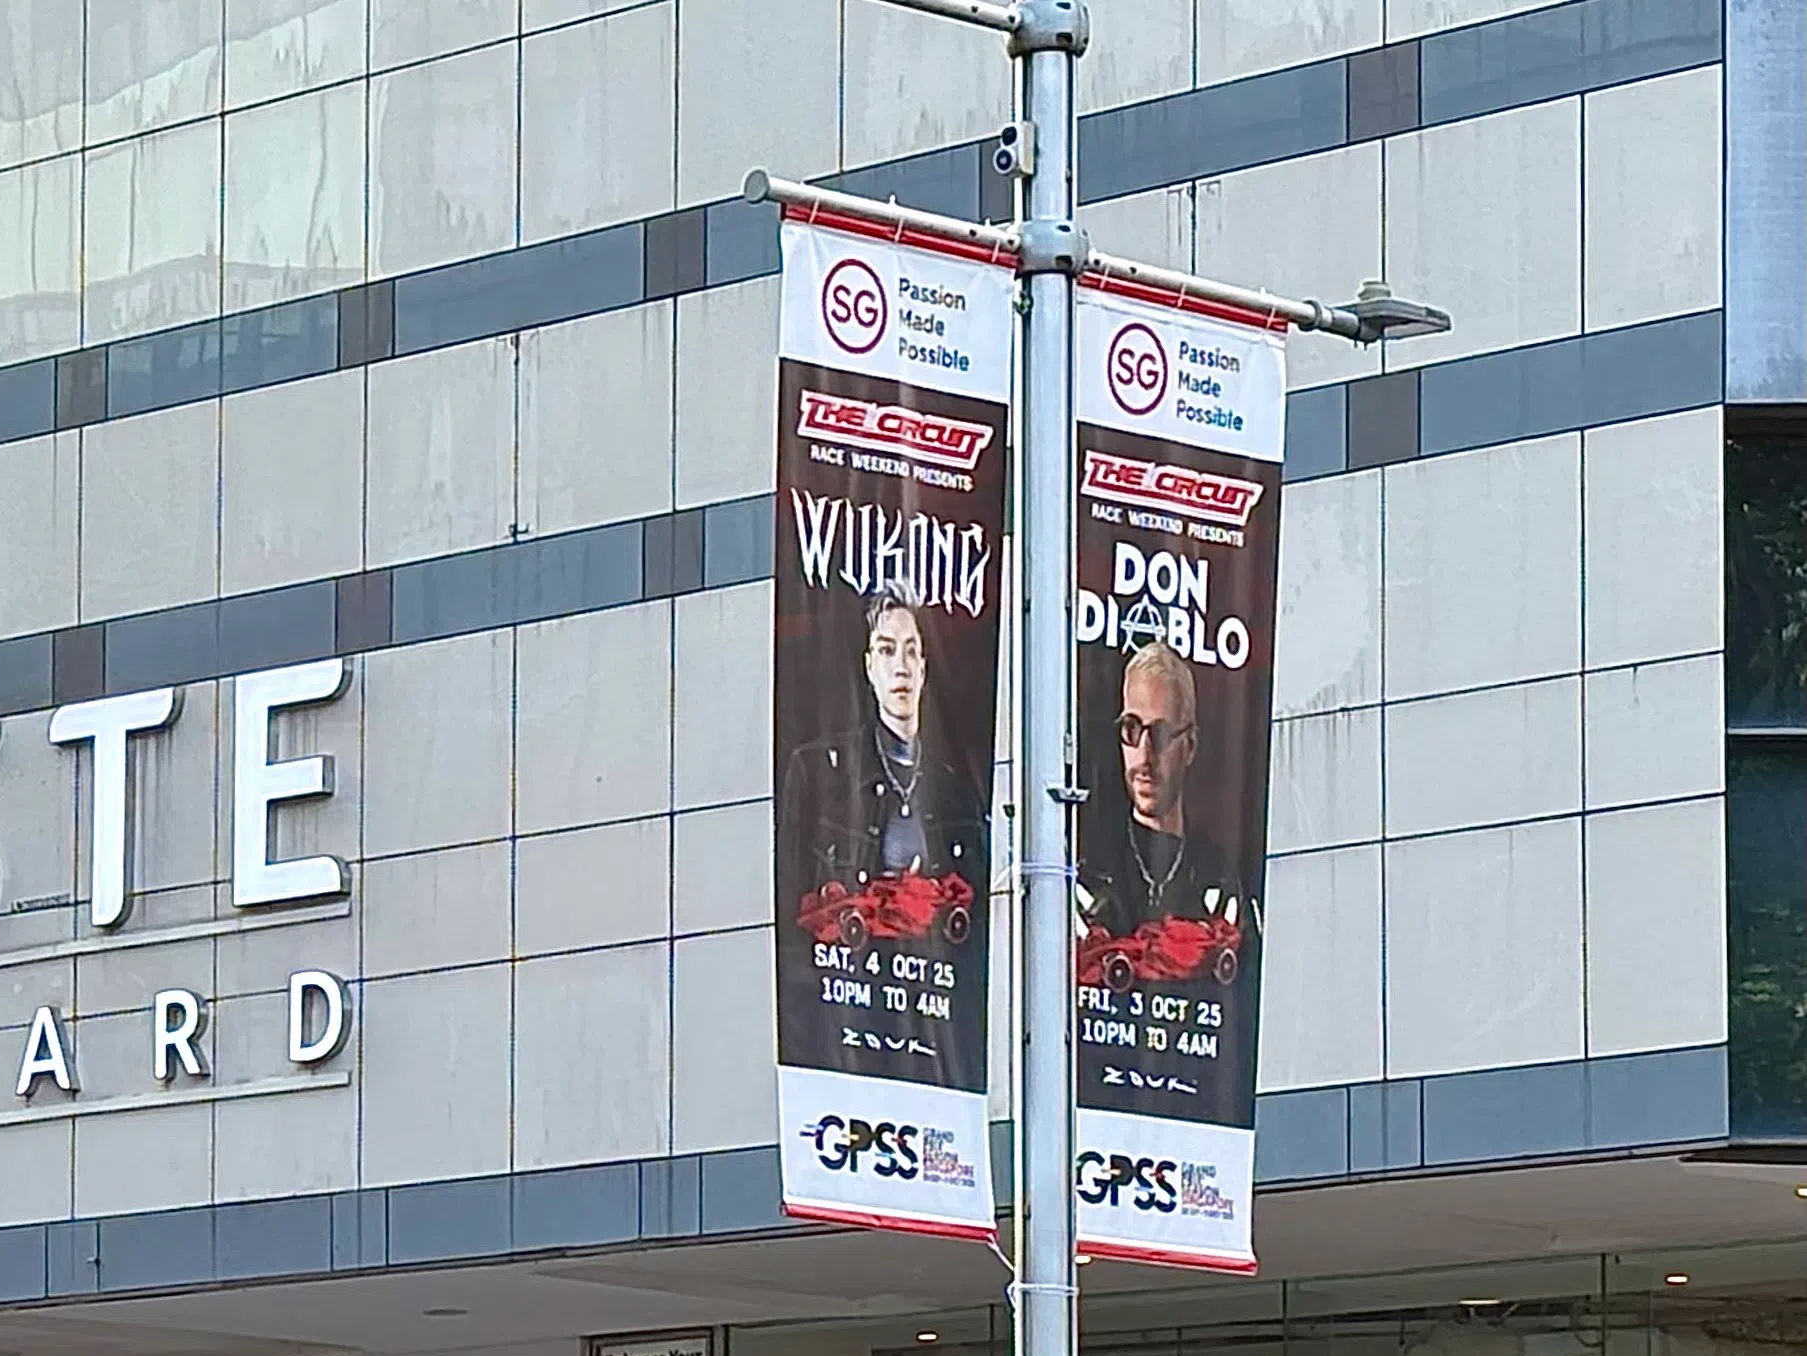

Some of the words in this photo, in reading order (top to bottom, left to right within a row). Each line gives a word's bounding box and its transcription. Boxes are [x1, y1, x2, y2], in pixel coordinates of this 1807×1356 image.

[830, 284, 879, 329] SG
[898, 277, 967, 312] Passion
[898, 308, 945, 337] Made
[898, 336, 970, 372] Possible
[1115, 347, 1160, 391] SG
[1178, 340, 1241, 373] Passion
[1177, 369, 1222, 398] Made
[806, 397, 867, 427] THE
[1176, 398, 1244, 431] Possible
[810, 444, 845, 465] RACE
[850, 452, 910, 478] WEEKEND
[913, 464, 975, 492] PRESENTS
[1090, 457, 1147, 486] THE
[1091, 502, 1123, 524] RACE
[1187, 522, 1245, 548] PRESENTS
[791, 486, 991, 618] WUKONG
[1113, 541, 1209, 614] DON
[1076, 588, 1250, 669] DIABLO
[865, 951, 881, 975] 4
[892, 953, 928, 982] OCT
[933, 962, 955, 989] 25
[821, 976, 872, 1008] 10PM
[882, 985, 908, 1012] TO
[916, 991, 951, 1021] 4AM
[1129, 992, 1144, 1016] 3
[1151, 994, 1189, 1022] OCT
[1196, 1001, 1222, 1028] 25
[1082, 1018, 1136, 1047] 10PM
[1145, 1025, 1168, 1052] TO
[1176, 1031, 1218, 1059] 4AM
[813, 1114, 919, 1181] GPSS
[1076, 1150, 1178, 1213] GPSS
